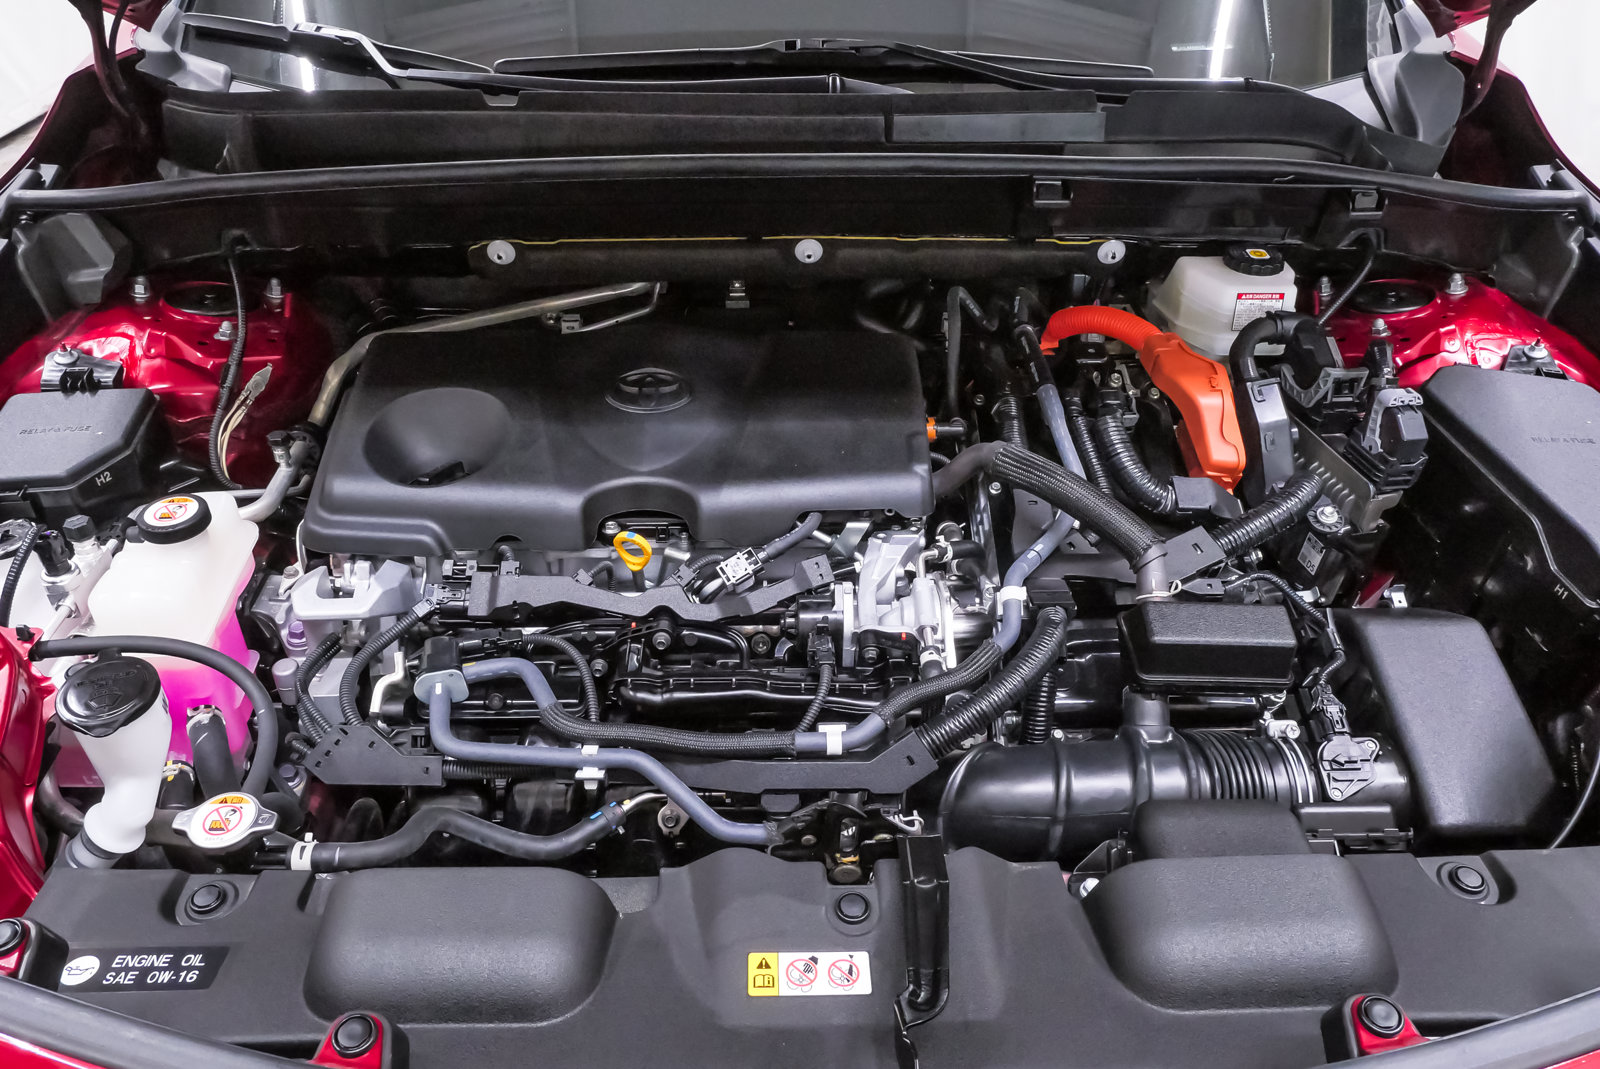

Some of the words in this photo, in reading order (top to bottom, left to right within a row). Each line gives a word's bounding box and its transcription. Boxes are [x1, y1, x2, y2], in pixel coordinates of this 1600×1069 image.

[96, 471, 113, 486] H2
[1554, 584, 1569, 600] H1
[112, 954, 173, 967] ENGINE
[181, 954, 205, 966] OIL
[102, 971, 139, 985] SAE
[146, 970, 199, 984] 0W-16
